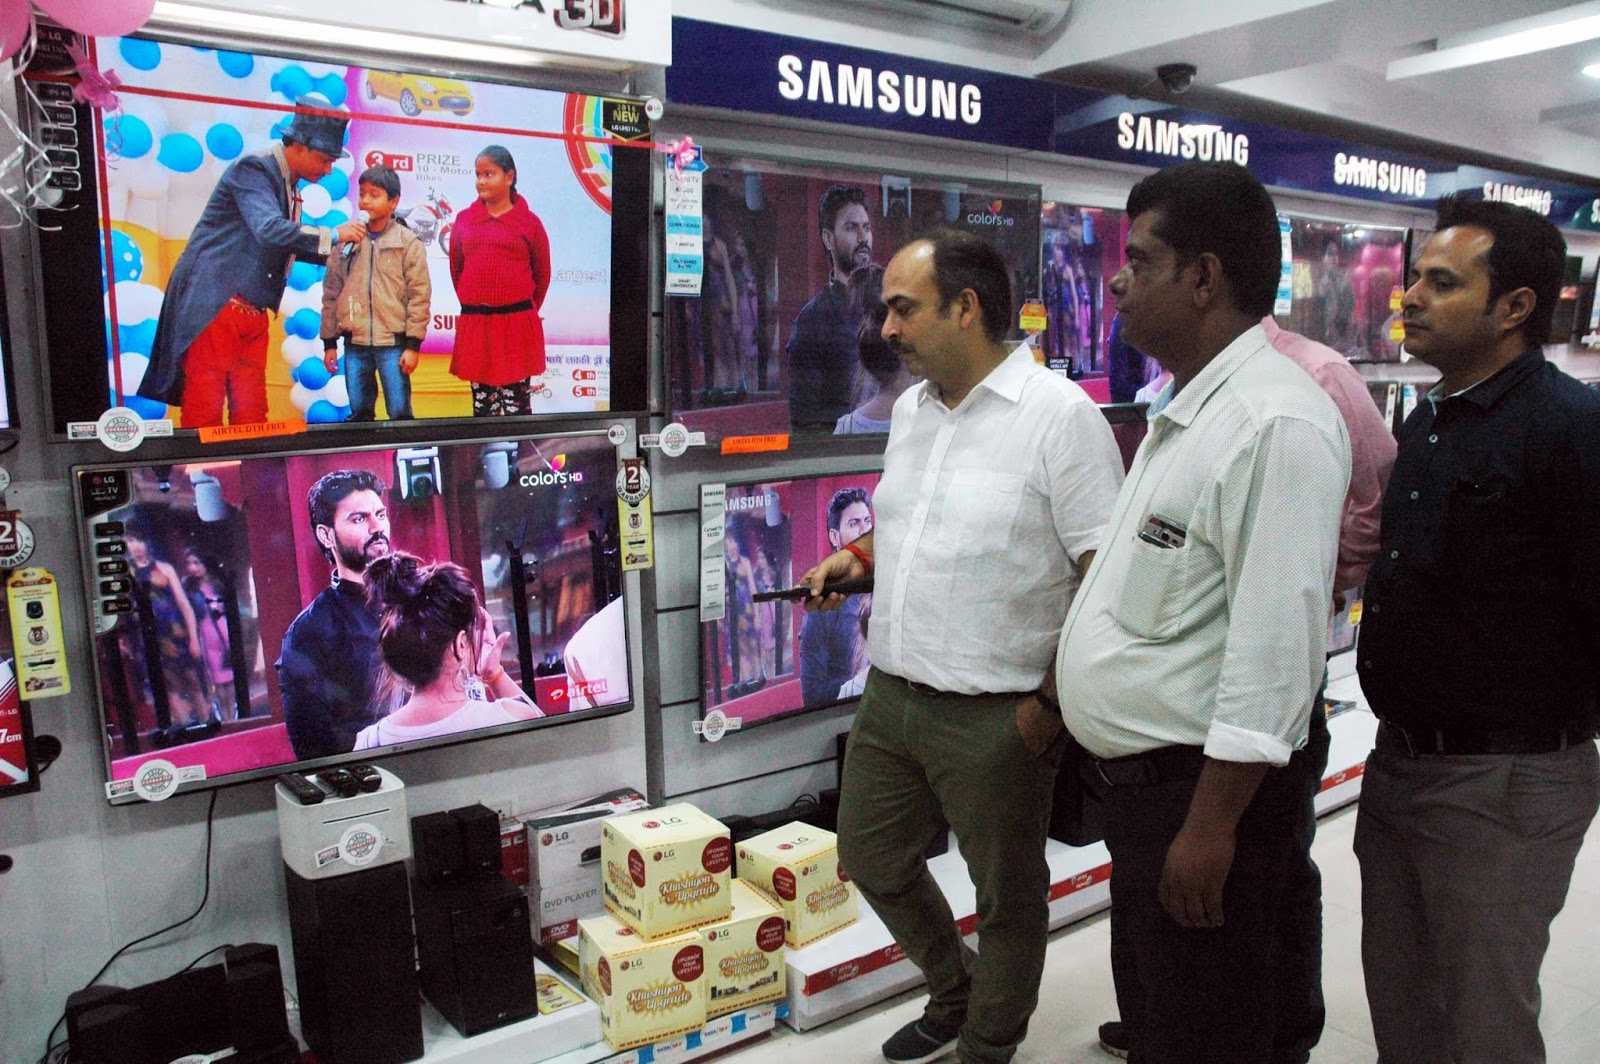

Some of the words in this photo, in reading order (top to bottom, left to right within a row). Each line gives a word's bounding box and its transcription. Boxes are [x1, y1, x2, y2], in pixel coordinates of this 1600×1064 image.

[778, 54, 982, 125] SAMSUNG
[613, 109, 639, 123] NEW
[1117, 112, 1249, 167] SAMSUNG
[416, 153, 460, 165] PRIZE
[441, 166, 473, 175] Motor
[1334, 152, 1427, 198] SAMSUNG
[1483, 181, 1552, 216] SAMSUNG
[967, 212, 1002, 225] colors
[212, 427, 243, 435] AIRTEL
[246, 425, 264, 433] DTH
[266, 422, 287, 431] FREE
[520, 471, 567, 487] colors
[569, 473, 582, 482] HD
[627, 466, 639, 484] 2
[617, 484, 649, 501] WARRANTY
[725, 494, 771, 511] AMSUNG
[0, 521, 14, 543] 2
[567, 680, 608, 697] airtel
[662, 816, 681, 825] LG
[556, 832, 569, 841] LG
[664, 850, 675, 858] LG
[747, 854, 754, 862] LG
[810, 864, 818, 873] LG
[544, 898, 562, 909] DVD
[565, 889, 597, 903] PLAYER
[676, 884, 718, 902] Upgrade
[551, 924, 569, 934] DVD
[718, 930, 729, 938] LG
[631, 959, 643, 968] LG
